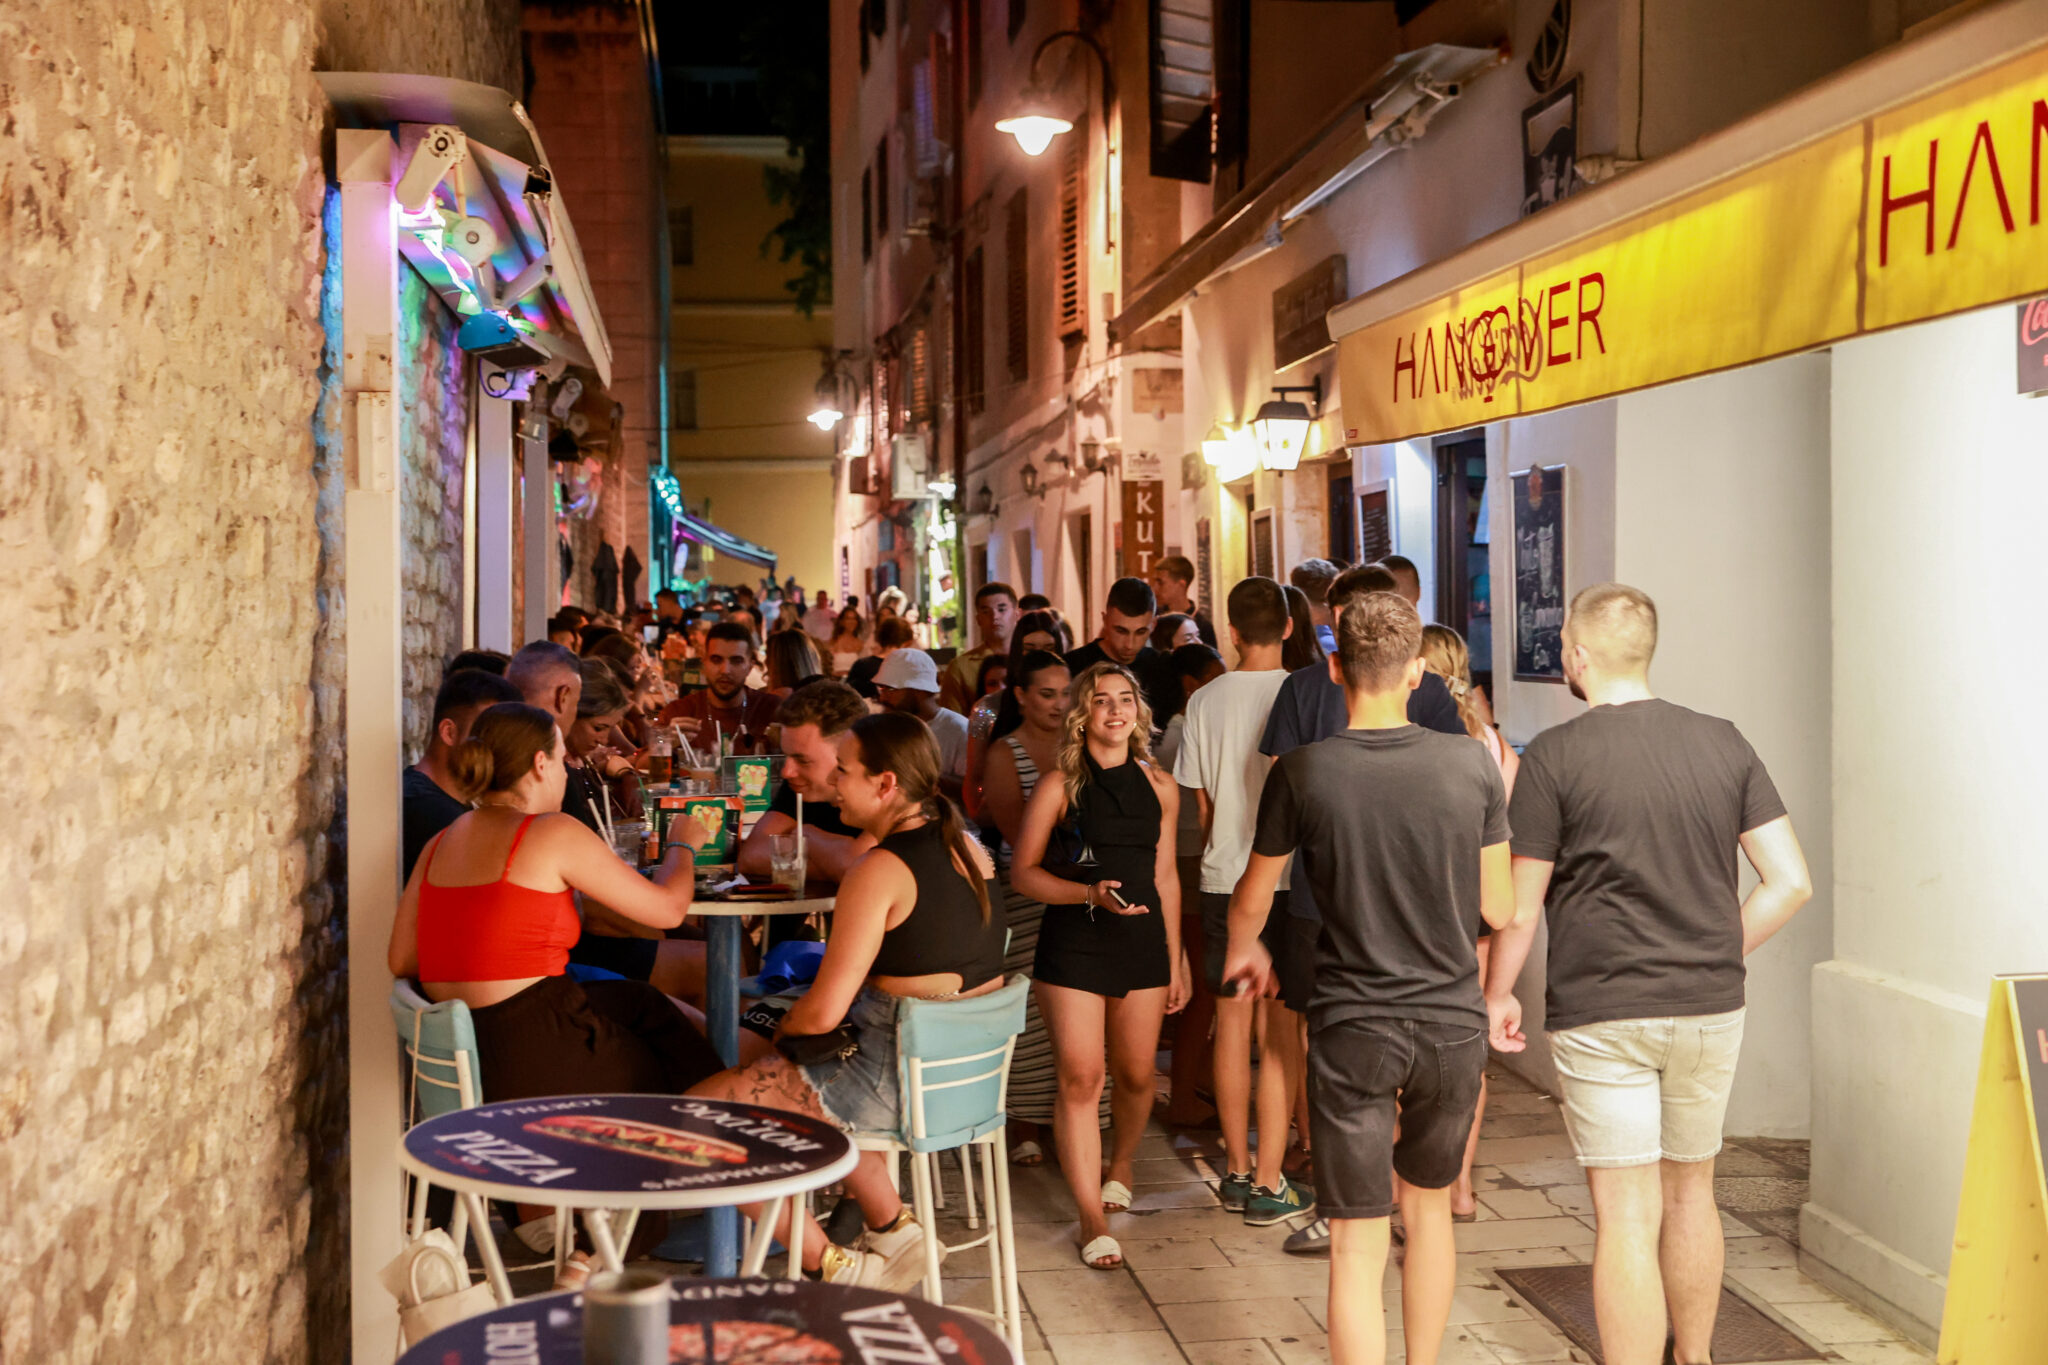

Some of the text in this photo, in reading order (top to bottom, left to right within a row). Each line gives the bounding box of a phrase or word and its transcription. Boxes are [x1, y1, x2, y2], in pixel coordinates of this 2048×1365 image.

[1136, 491, 1155, 584] KUT
[671, 1102, 755, 1128] DOG
[738, 1126, 823, 1152] HOT
[432, 1129, 578, 1185] PIZZA
[669, 1282, 796, 1300] SAND
